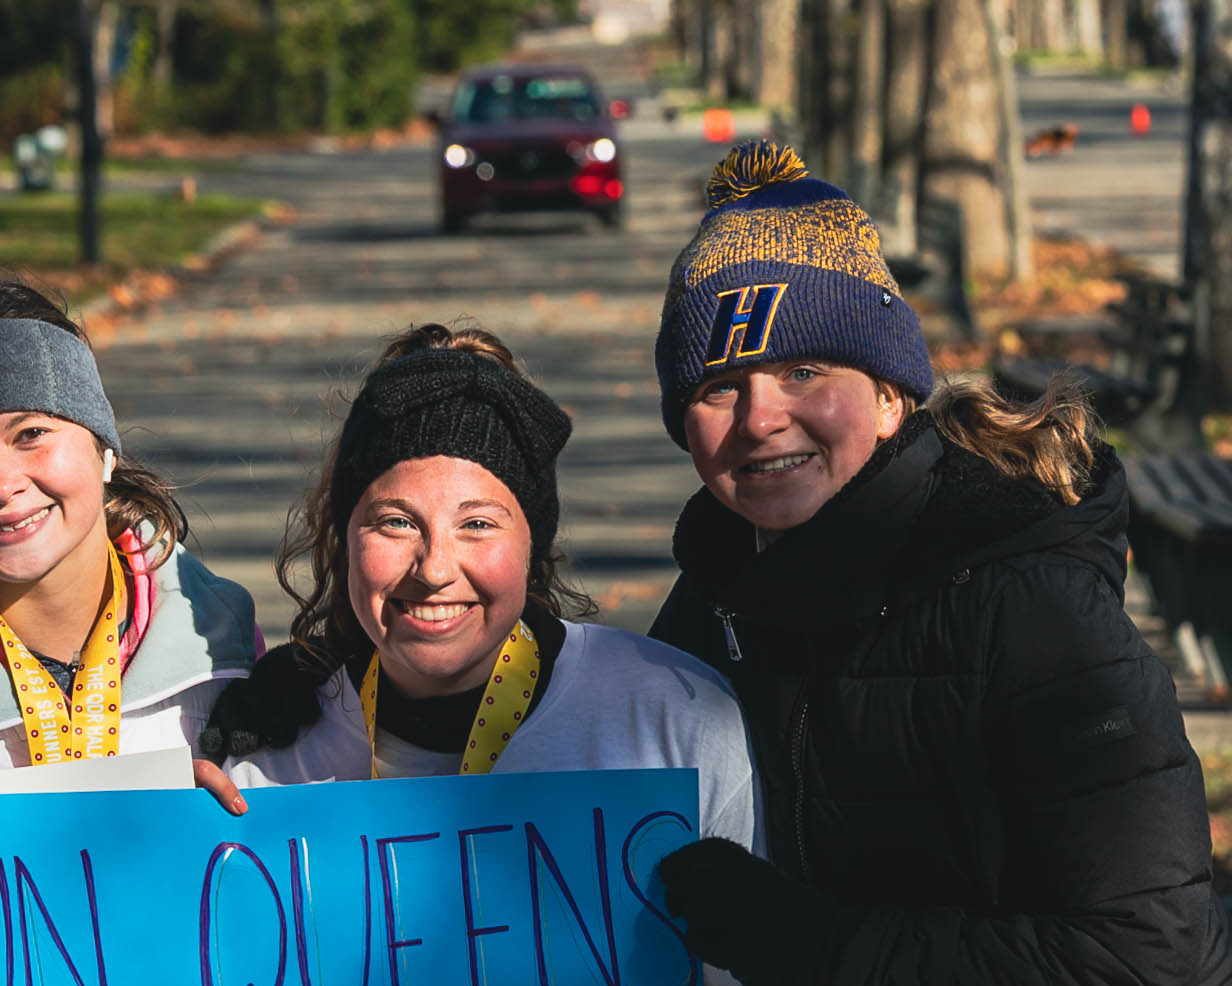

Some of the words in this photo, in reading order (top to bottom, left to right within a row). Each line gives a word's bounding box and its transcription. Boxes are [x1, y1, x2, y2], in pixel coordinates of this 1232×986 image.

[705, 283, 788, 366] H
[86, 664, 104, 691] THE
[35, 699, 61, 763] UNNERS
[86, 693, 104, 723] QDR
